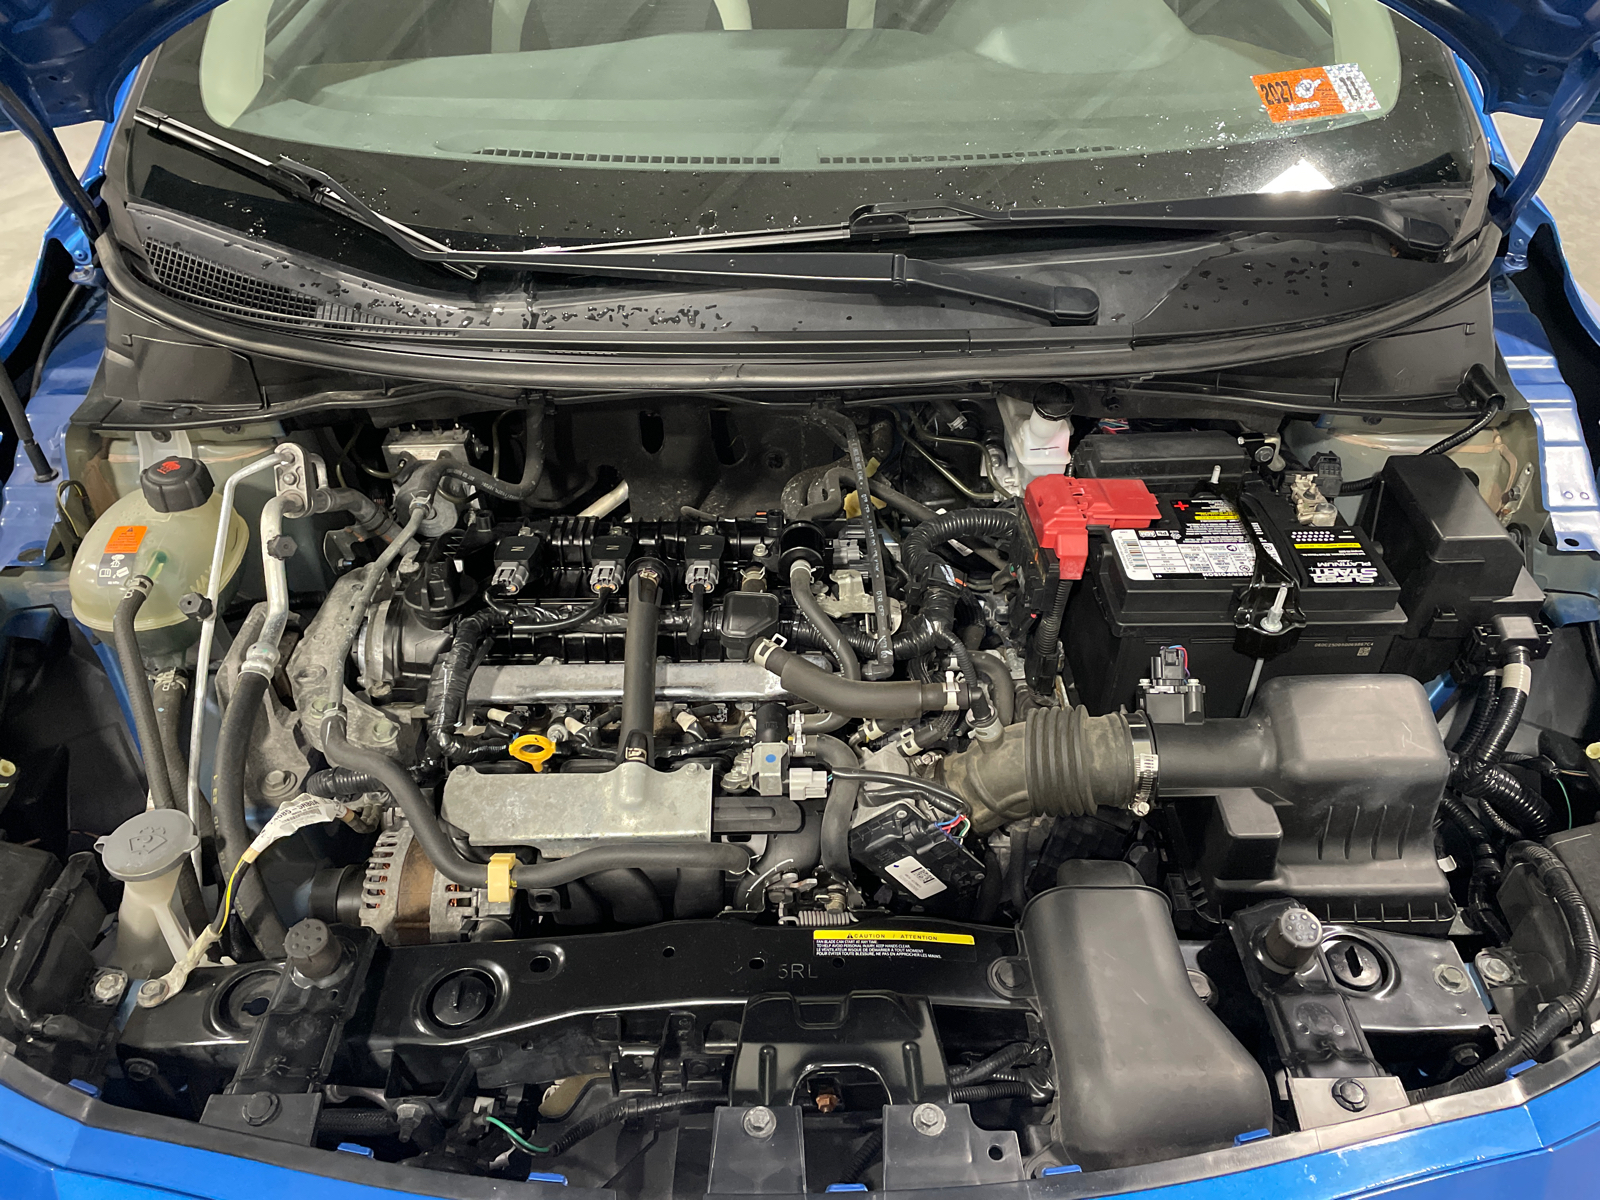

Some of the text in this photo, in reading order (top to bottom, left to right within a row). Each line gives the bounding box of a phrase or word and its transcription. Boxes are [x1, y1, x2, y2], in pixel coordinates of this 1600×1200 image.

[1259, 80, 1295, 106] 2027
[1338, 76, 1362, 101] 11
[1308, 567, 1379, 578] START
[1313, 574, 1375, 584] SUPER
[778, 963, 818, 980] 5RL
